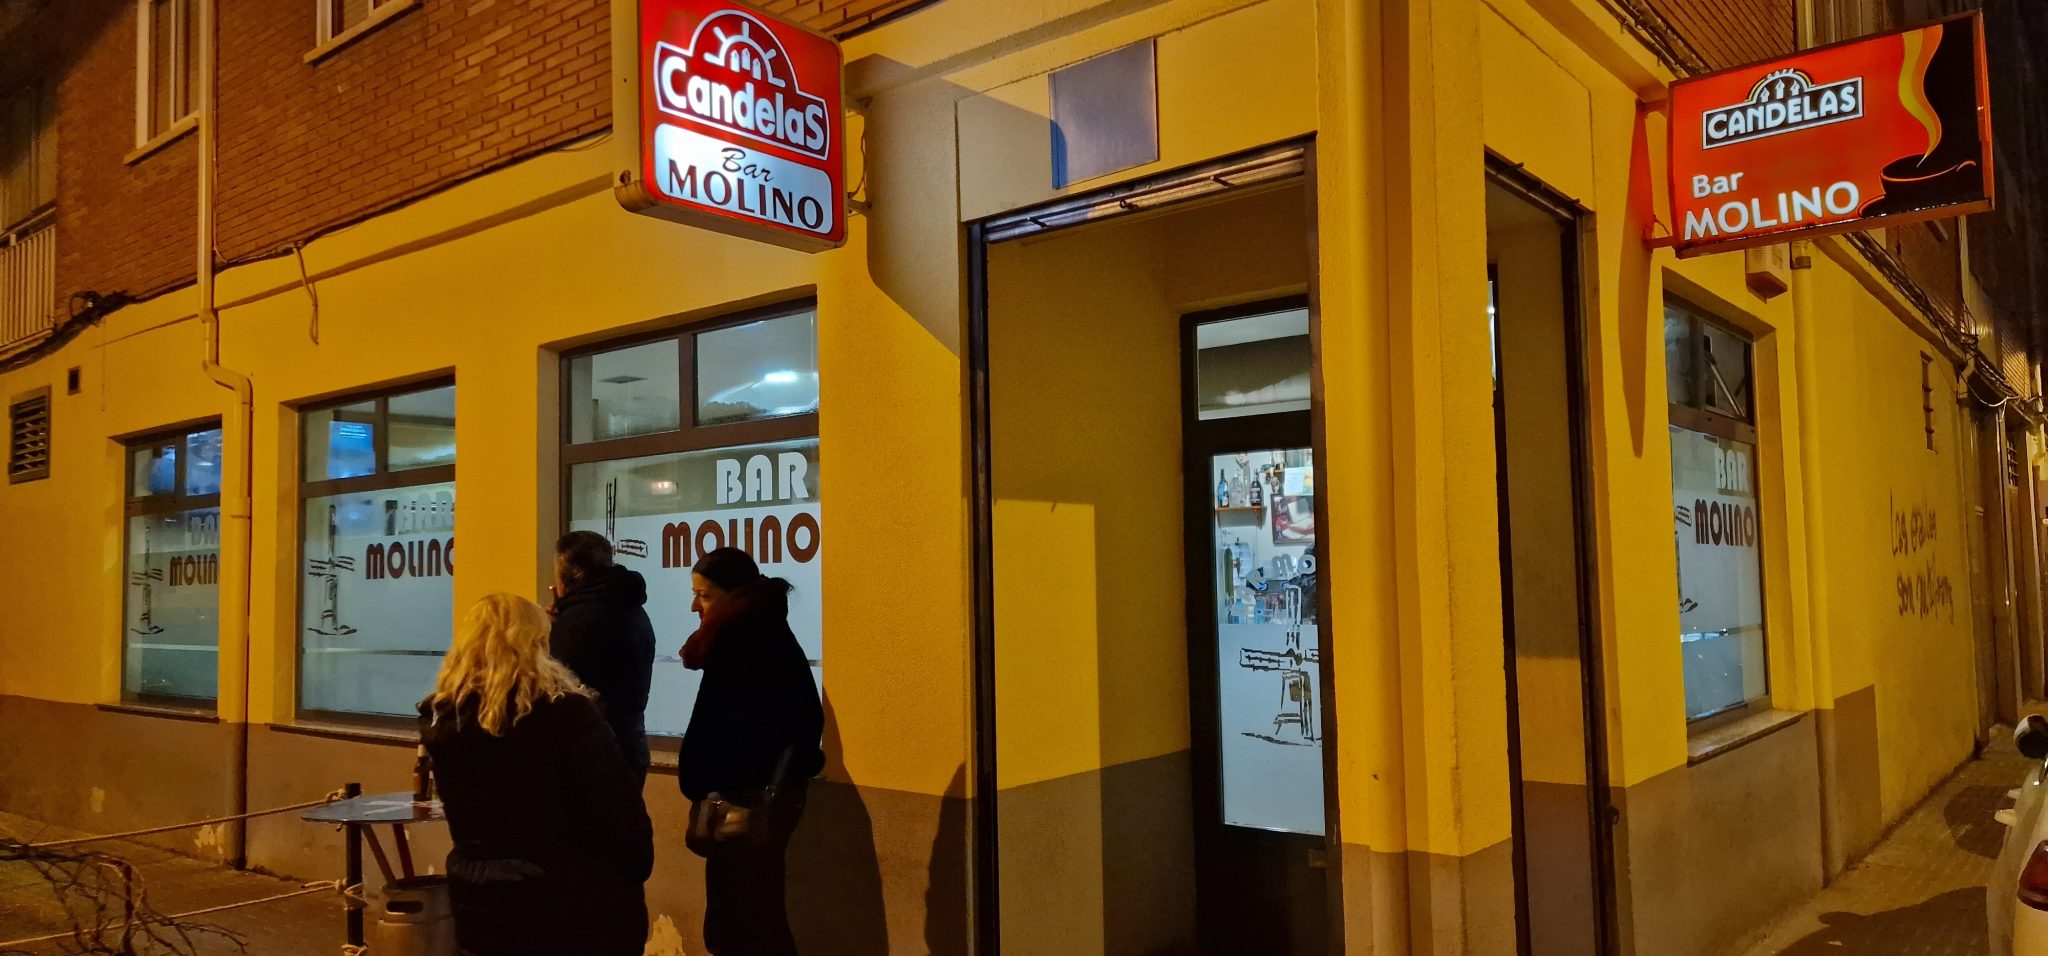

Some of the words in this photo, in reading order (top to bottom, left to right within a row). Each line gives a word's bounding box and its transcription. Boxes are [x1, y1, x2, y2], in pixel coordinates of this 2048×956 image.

[662, 56, 825, 151] Candelas
[1707, 85, 1855, 140] CANDELAS
[721, 147, 775, 183] Bar
[1692, 171, 1744, 199] Bar
[668, 159, 825, 230] MOLINO
[1684, 181, 1860, 240] MOLINO
[716, 451, 809, 505] BAR
[1714, 446, 1750, 493] BAR
[1695, 498, 1755, 548] MOLINO
[169, 552, 218, 587] MOLIN
